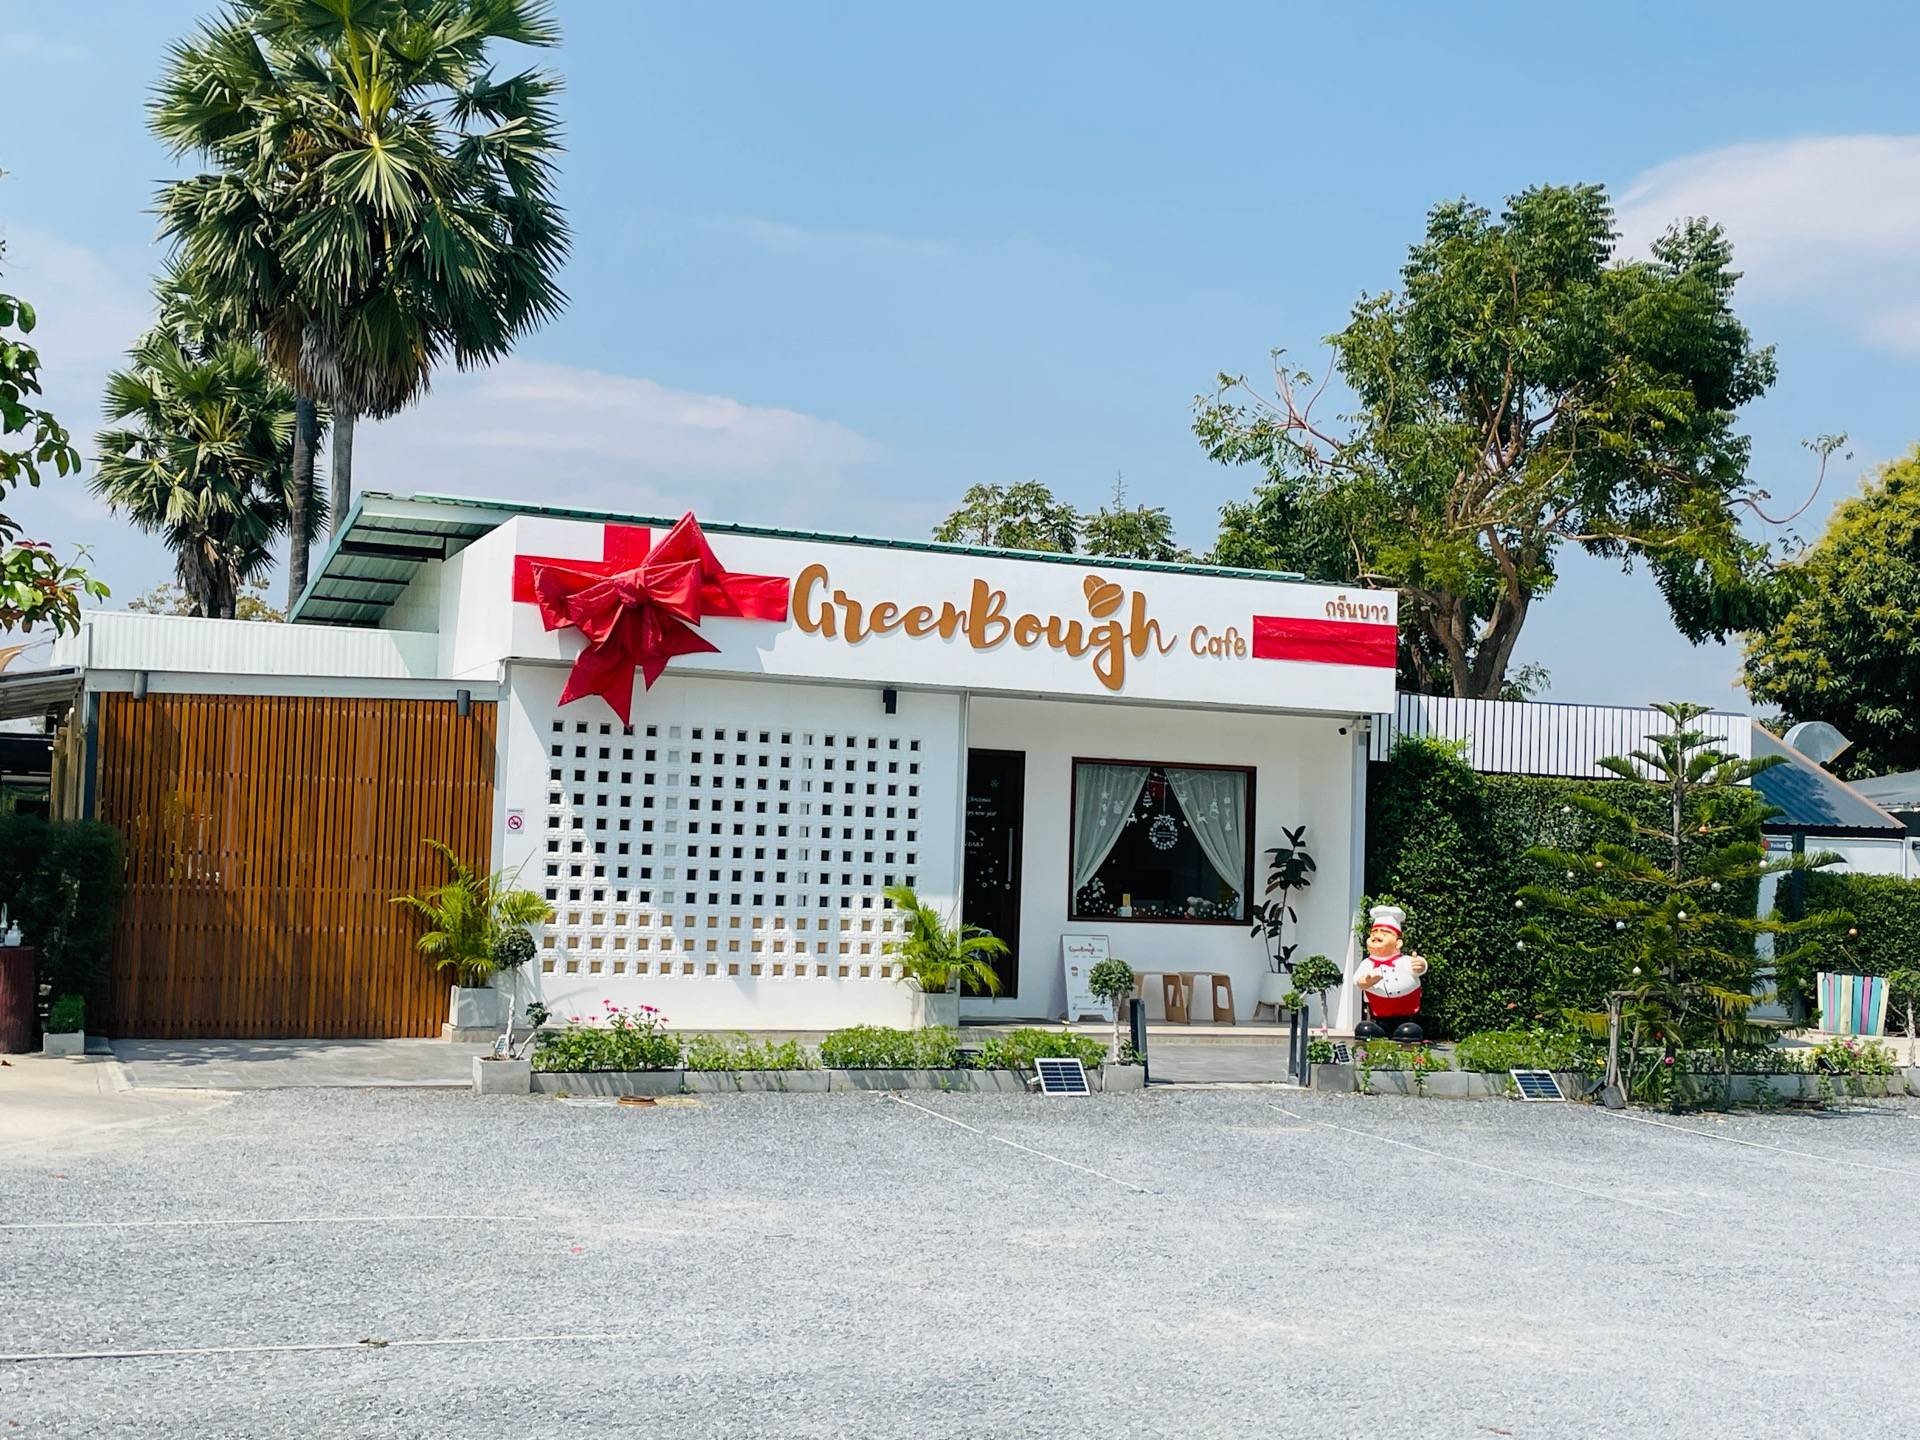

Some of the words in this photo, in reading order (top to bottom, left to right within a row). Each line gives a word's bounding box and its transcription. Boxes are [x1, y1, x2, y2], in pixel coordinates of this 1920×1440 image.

[792, 563, 1177, 691] GreenBough
[1190, 625, 1247, 657] Cafe
[1325, 594, 1389, 621] กรีนบาว
